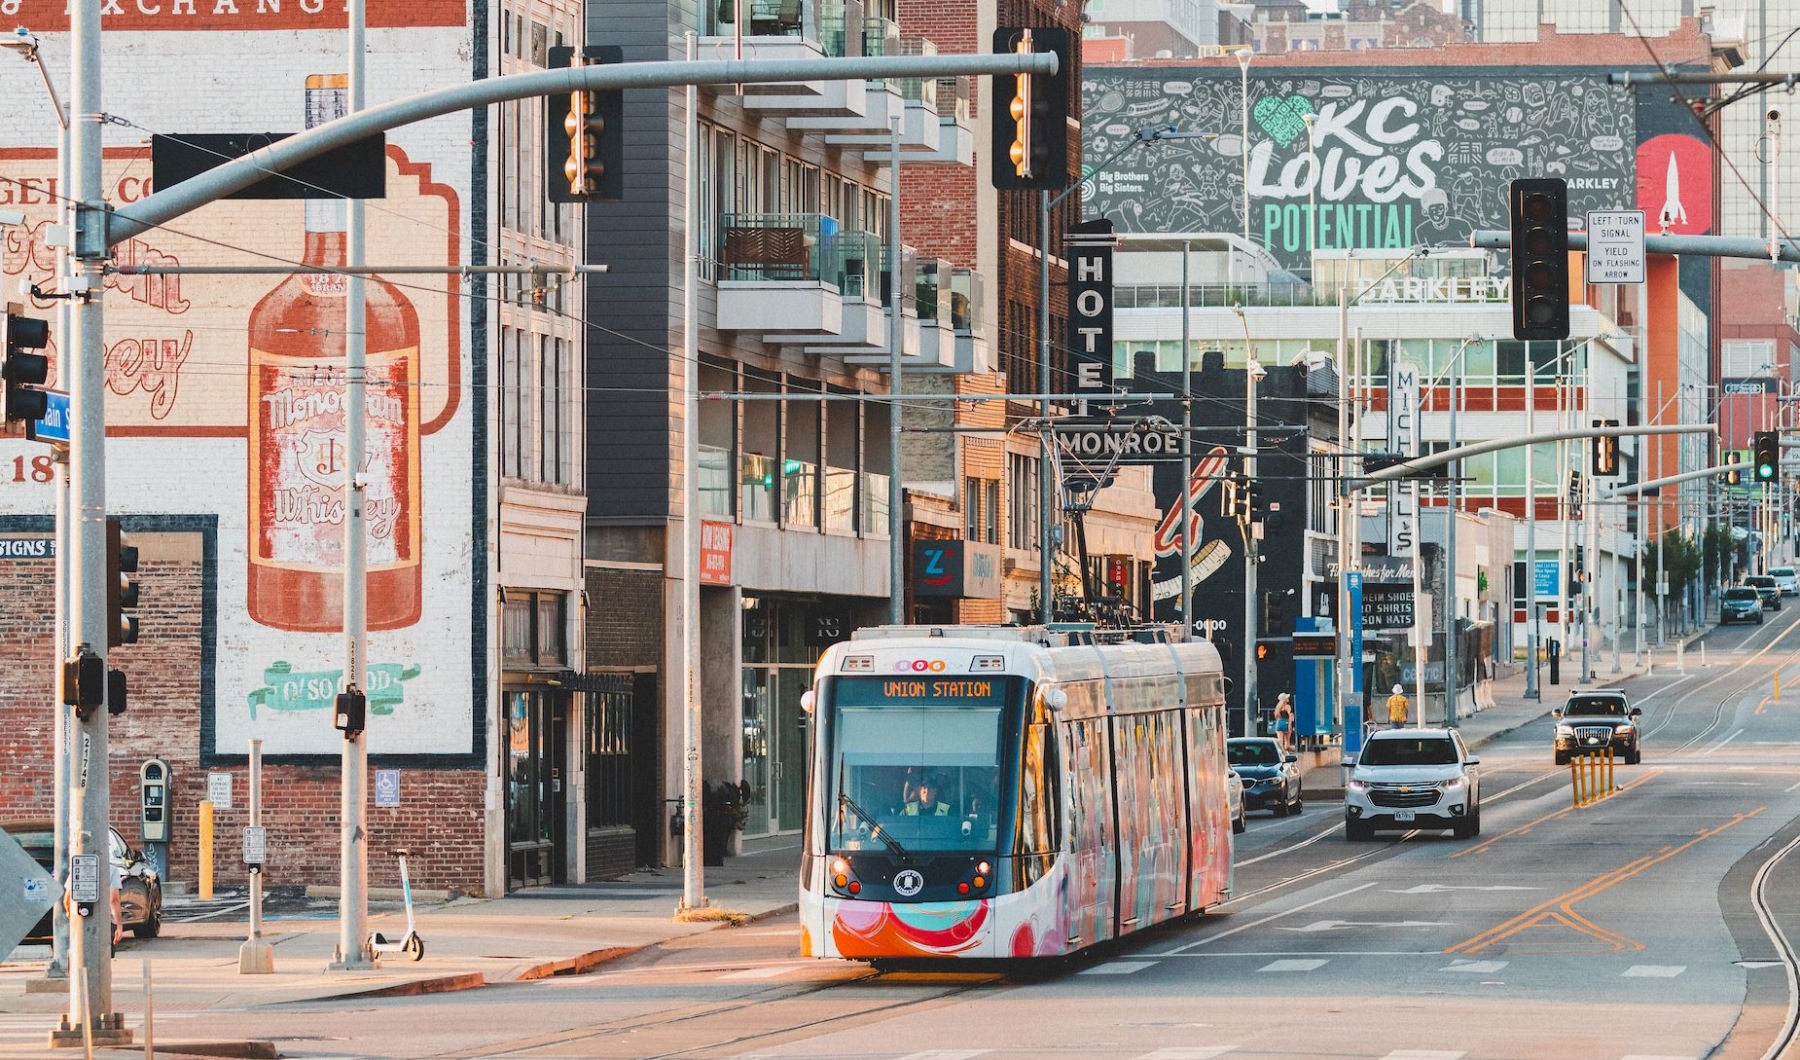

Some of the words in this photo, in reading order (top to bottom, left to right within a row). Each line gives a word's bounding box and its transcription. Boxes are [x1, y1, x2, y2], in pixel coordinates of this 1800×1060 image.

[1314, 97, 1420, 156] KC
[1100, 171, 1113, 183] Big
[1114, 171, 1149, 181] Brothers
[1562, 178, 1619, 189] ARKLEY
[1100, 183, 1113, 195] Big
[1114, 183, 1145, 192] Sisters.
[1592, 217, 1611, 225] LEFT
[1618, 217, 1639, 225] TURN
[1358, 277, 1511, 300] BARKLEY
[1060, 432, 1180, 454] MONROE
[274, 485, 402, 540] Whisey
[1377, 603, 1412, 613] SHIRTS
[1386, 615, 1412, 625] HATS
[307, 676, 333, 700] SO
[883, 681, 926, 697] UNION
[932, 681, 991, 697] STATION
